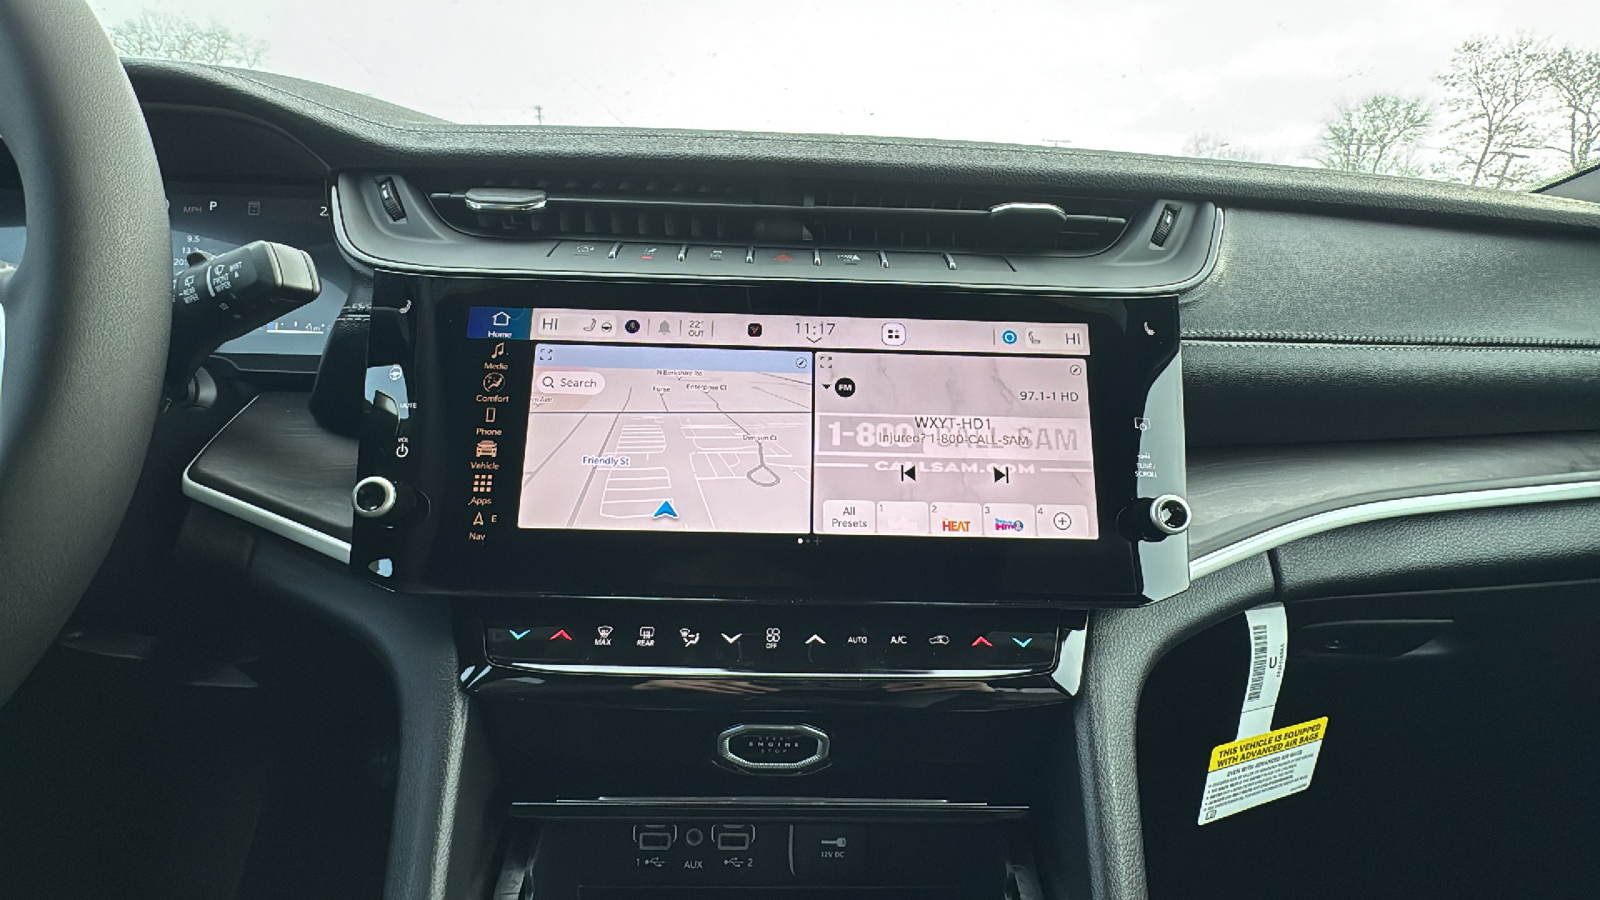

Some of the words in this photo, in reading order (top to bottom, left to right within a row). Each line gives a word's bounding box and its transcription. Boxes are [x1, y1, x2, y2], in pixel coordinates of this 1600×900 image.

[209, 201, 218, 211] P
[186, 235, 200, 243] 9.5
[213, 273, 229, 286] FRONT
[542, 318, 558, 330] HI
[795, 322, 836, 335] 11:17
[488, 330, 512, 339] Home
[1065, 333, 1081, 345] HI
[484, 362, 508, 370] Media
[560, 378, 597, 388] Search
[475, 394, 510, 403] Comfort
[1019, 391, 1056, 401] 97.1-1
[1061, 392, 1079, 402] HD
[914, 416, 991, 430] WXYT-HD1
[476, 427, 502, 436] Phone
[828, 421, 914, 448] 1-800
[879, 432, 926, 445] Injured?
[470, 462, 499, 470] Vehicle
[582, 456, 619, 467] Friendly
[620, 456, 629, 466] St
[1134, 470, 1158, 479] SCROLL
[470, 496, 492, 506] Apps
[842, 506, 856, 516] All
[879, 504, 883, 512] 1
[931, 505, 937, 513] 2
[984, 506, 990, 514] 3
[1037, 507, 1043, 515] 4
[491, 515, 497, 523] E
[831, 518, 868, 528] Presets
[942, 520, 971, 532] HEAT
[468, 532, 485, 541] Nav
[595, 638, 612, 646] MAX
[848, 636, 867, 644] AUTO
[890, 636, 908, 644] A/C
[1219, 747, 1238, 758] THIS
[1239, 738, 1273, 752] VEHICLE
[1274, 734, 1283, 743] IS
[1283, 723, 1322, 740] EQUIPPED
[1217, 757, 1239, 768] WITH
[1239, 744, 1284, 761] ADVANCED
[1284, 739, 1298, 748] AIR
[1298, 732, 1319, 744] BAGS
[636, 858, 640, 867] 1
[683, 860, 703, 869] AUX
[747, 858, 753, 868] 2
